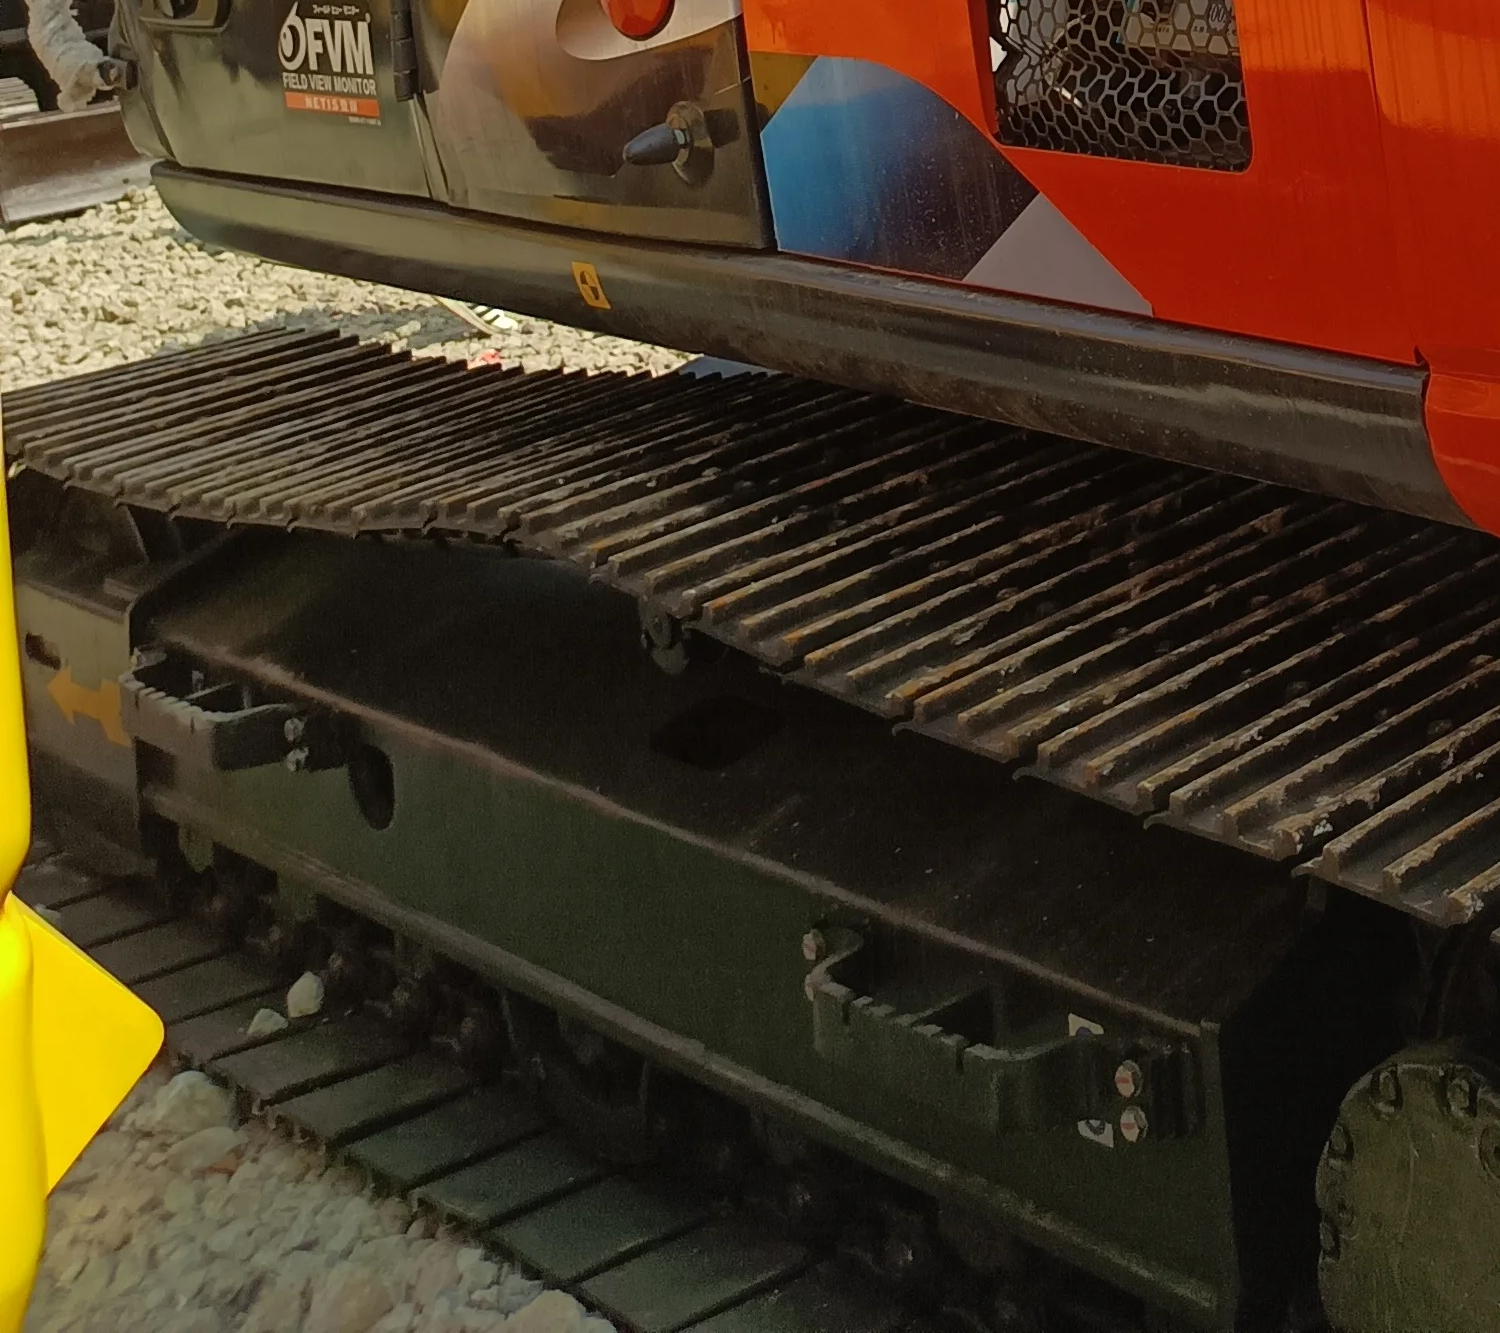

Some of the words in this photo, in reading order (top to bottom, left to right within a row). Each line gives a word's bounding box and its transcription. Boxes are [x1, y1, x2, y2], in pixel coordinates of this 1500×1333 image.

[282, 72, 309, 90] FIELD
[307, 73, 332, 92] VIEW
[333, 75, 377, 96] MONITOR
